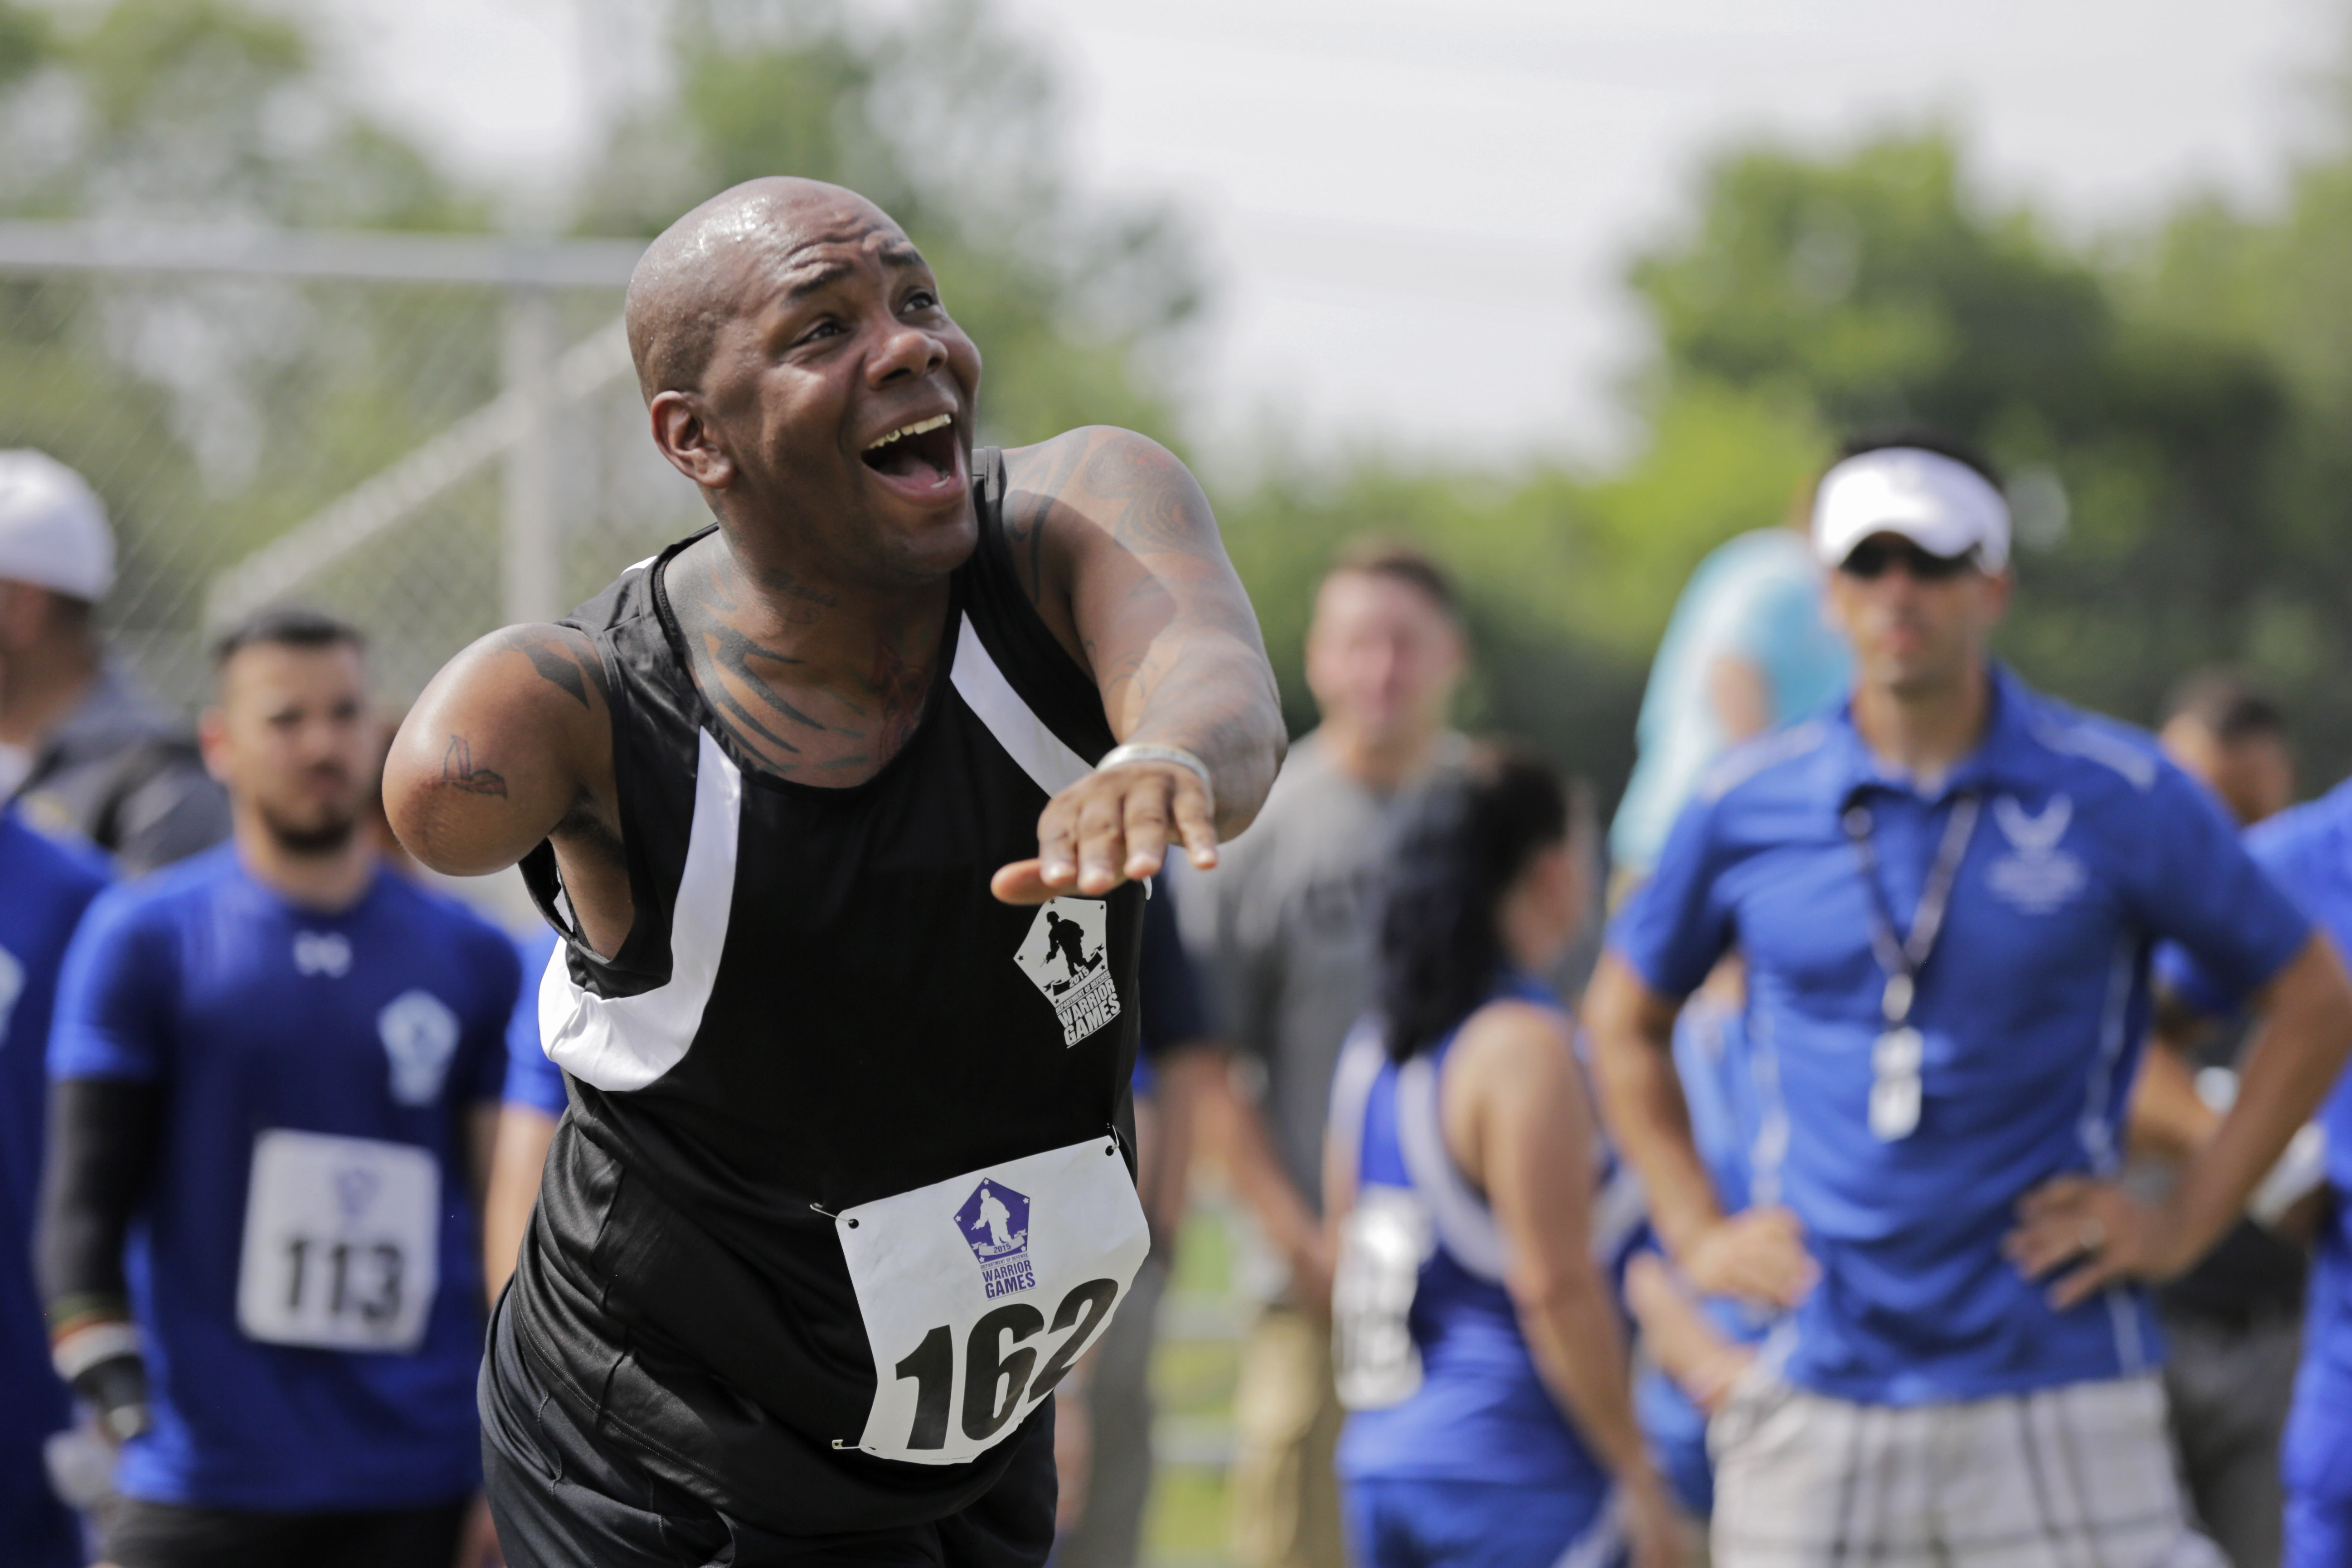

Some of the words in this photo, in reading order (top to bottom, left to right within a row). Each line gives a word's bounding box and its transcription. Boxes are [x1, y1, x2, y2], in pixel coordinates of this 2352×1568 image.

[1056, 989, 1084, 1013] DEPARTMENT
[1084, 985, 1091, 993] OF
[1090, 970, 1111, 989] DEFENSE
[1069, 966, 1089, 987] 2015
[1057, 978, 1116, 1028] WARRIOR
[1064, 993, 1120, 1046] GAMES
[981, 1259, 1005, 1269] DEPARTMENT
[1011, 1253, 1028, 1261] DEFENSE
[994, 1243, 1011, 1253] 2015
[287, 1236, 404, 1321] 113
[982, 1260, 1031, 1282] WARRIOR
[985, 1272, 1035, 1298] GAMES
[895, 1278, 1118, 1450] 162
